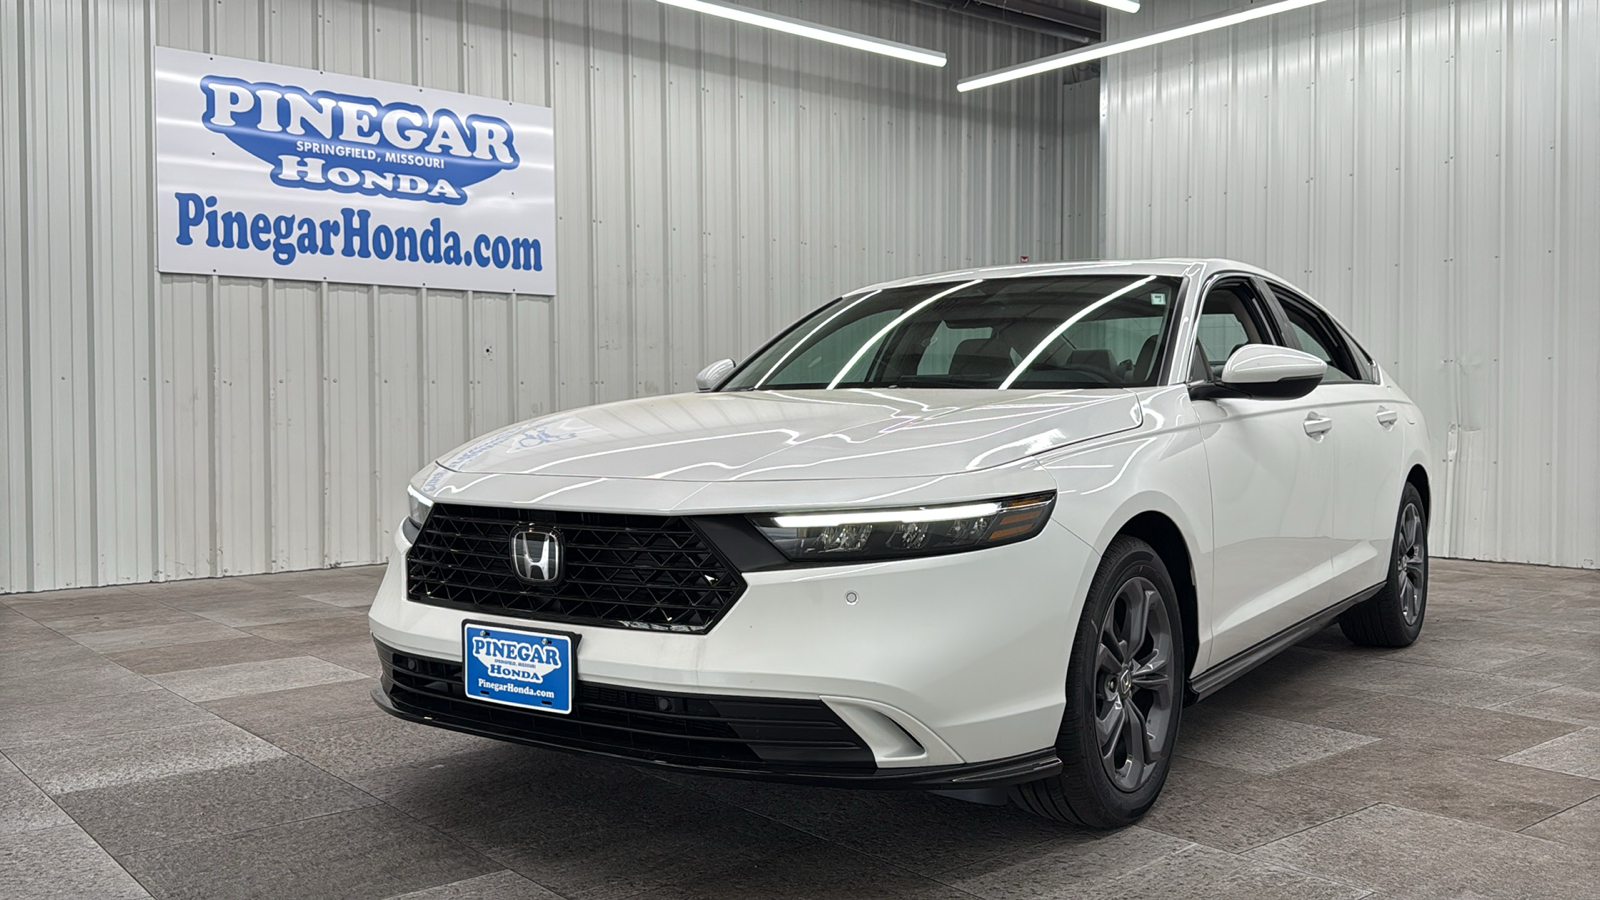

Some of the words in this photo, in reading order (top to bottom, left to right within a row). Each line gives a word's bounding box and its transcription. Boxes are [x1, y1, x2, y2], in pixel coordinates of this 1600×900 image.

[208, 82, 514, 164] PINEGAR
[296, 140, 381, 163] SPRINGFIELD,
[386, 152, 445, 170] MISSOURI
[277, 155, 462, 200] HONDA
[175, 192, 543, 272] PinegarHonda.com
[474, 639, 560, 665] PINEGAR
[490, 664, 541, 681] HONDA
[478, 678, 554, 698] PinegarHonda.com
